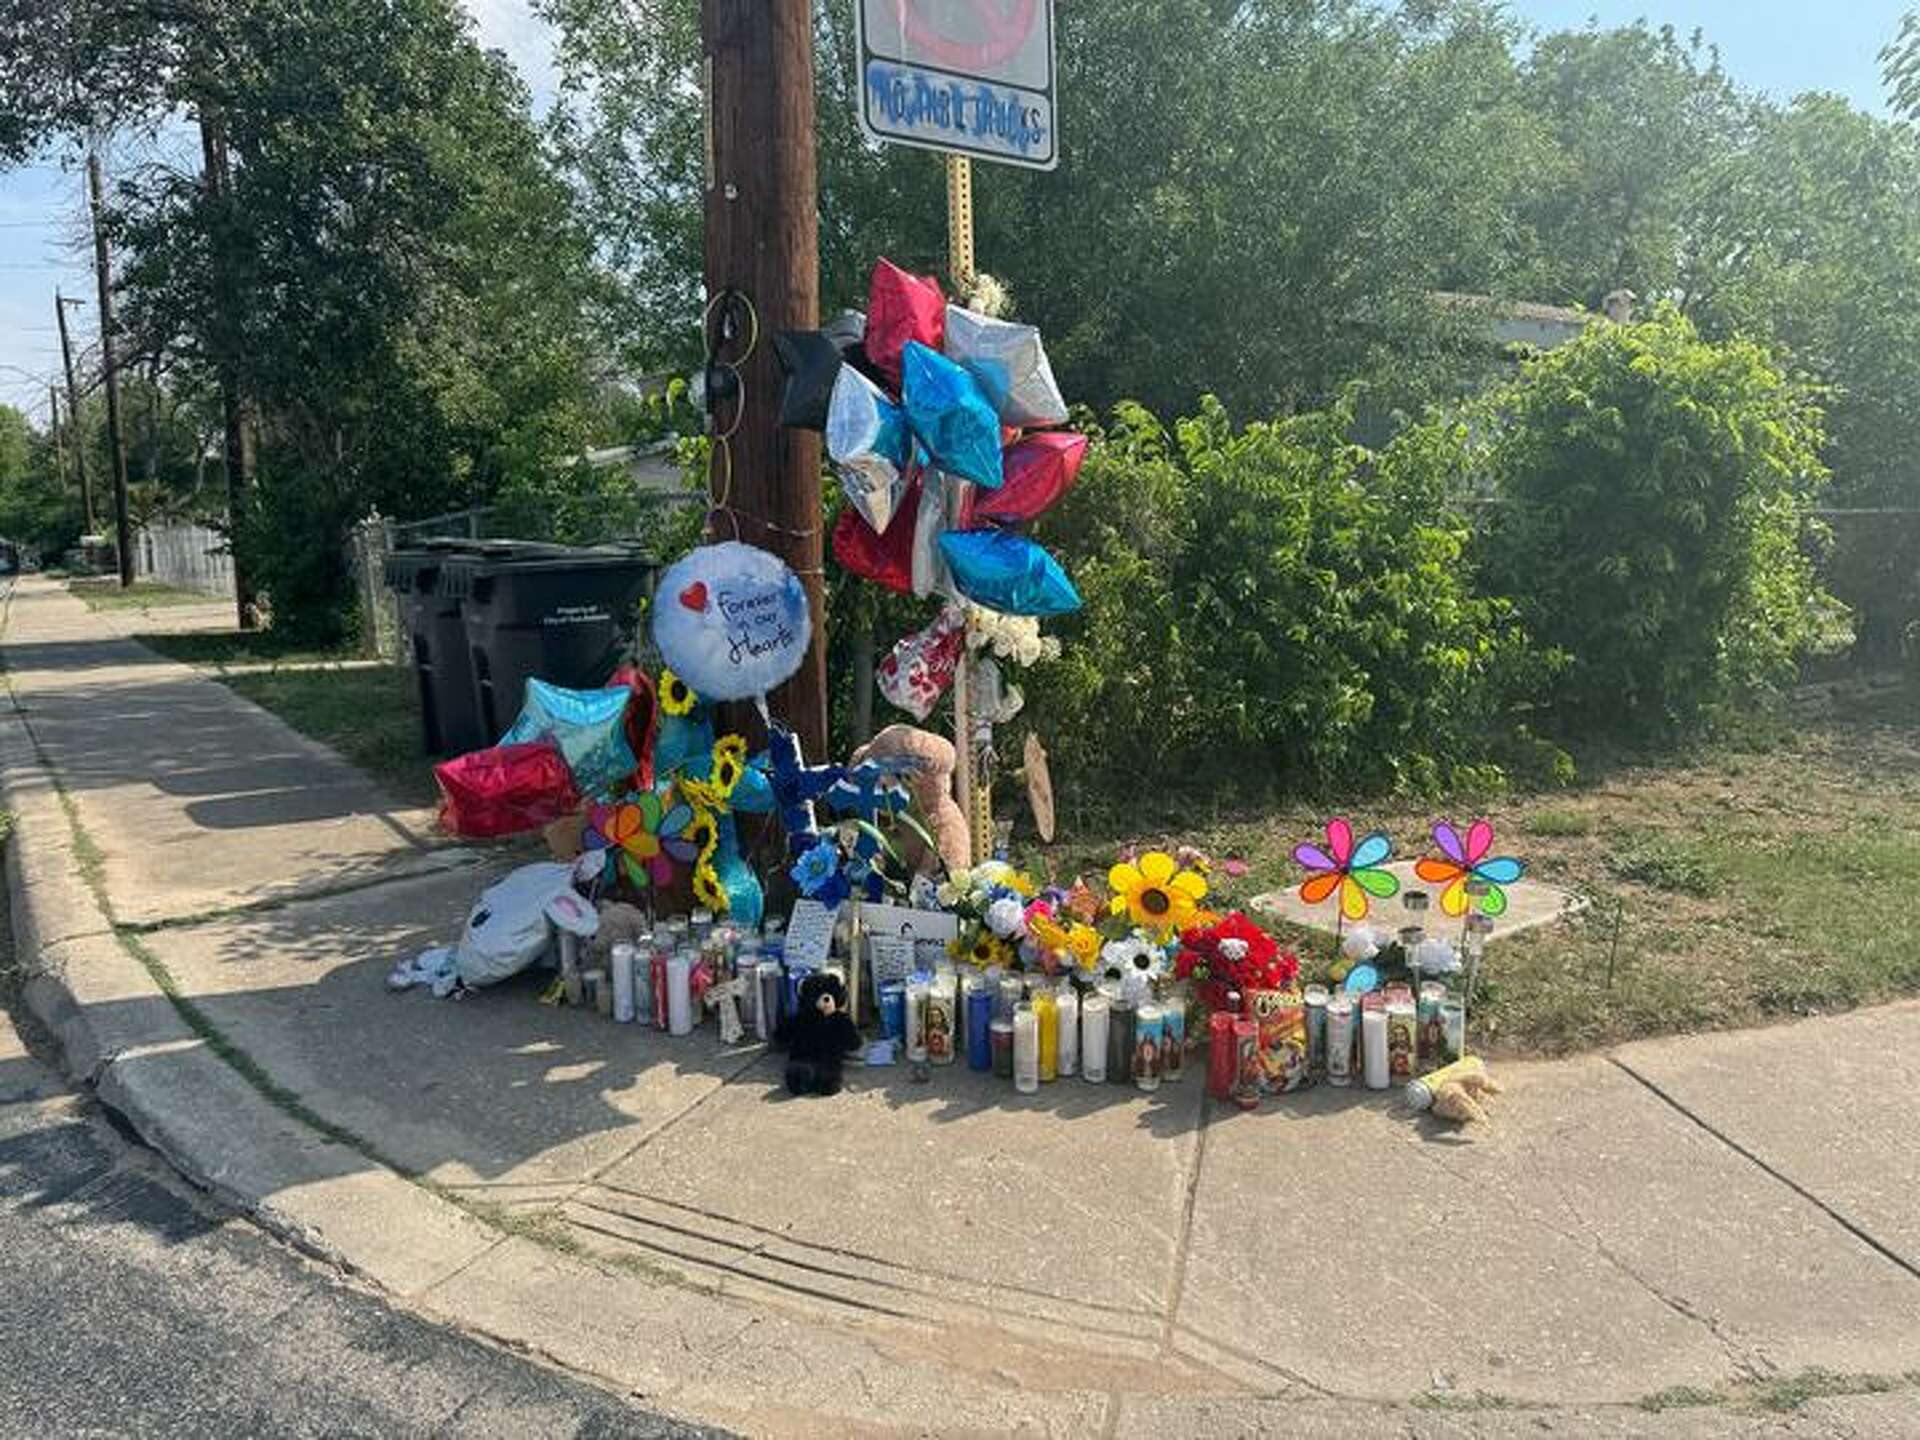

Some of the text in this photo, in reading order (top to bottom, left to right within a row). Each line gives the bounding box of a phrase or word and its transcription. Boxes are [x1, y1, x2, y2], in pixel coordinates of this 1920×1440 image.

[717, 591, 776, 621] Forever
[755, 612, 776, 625] our
[728, 623, 793, 664] Hearts
